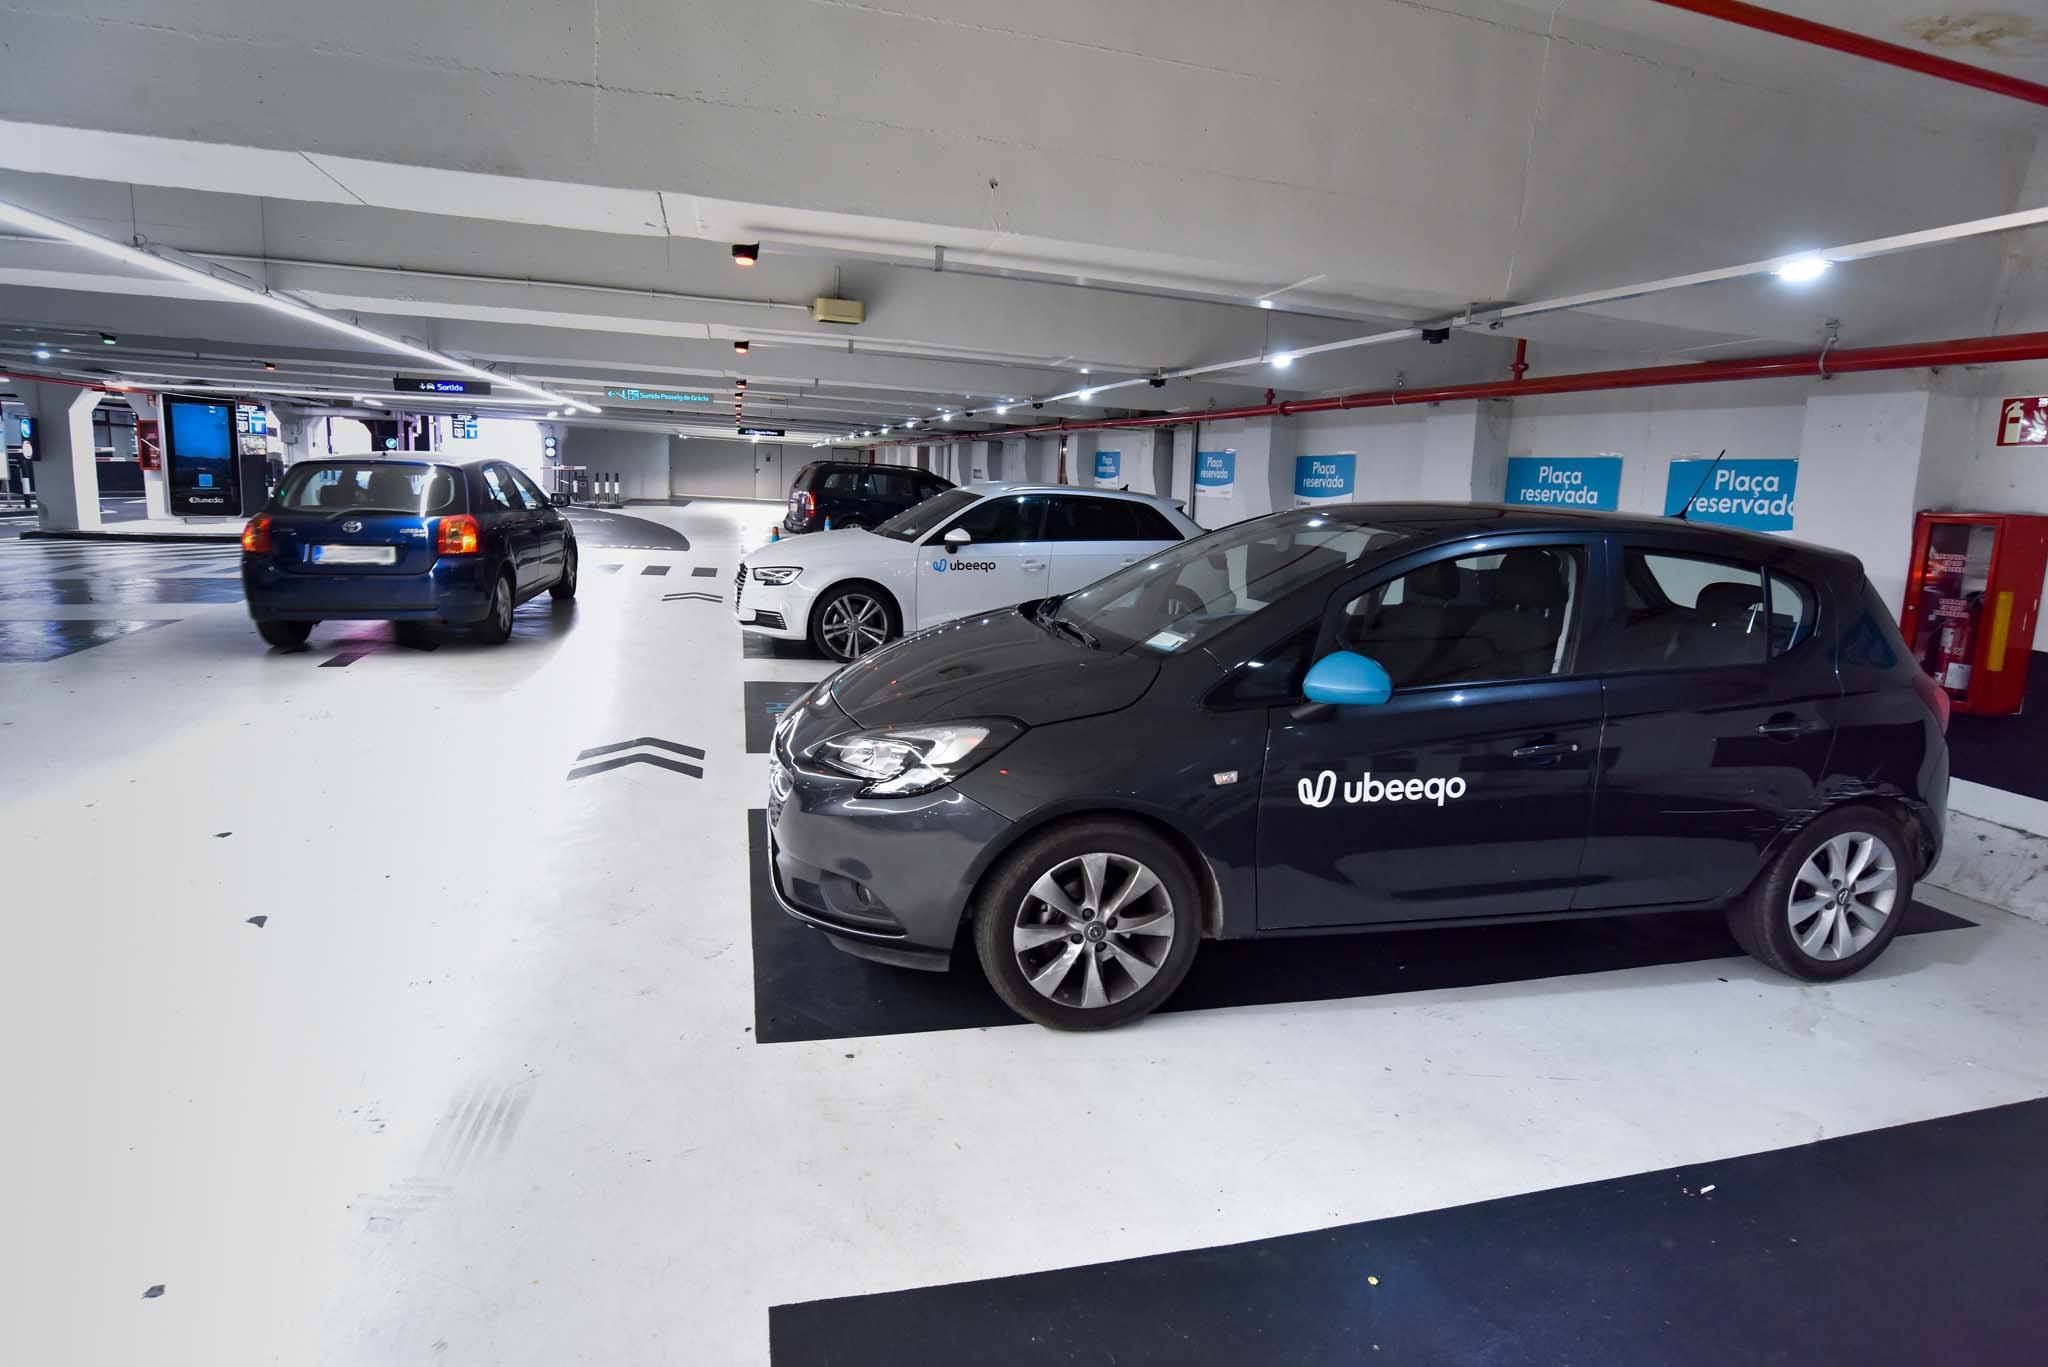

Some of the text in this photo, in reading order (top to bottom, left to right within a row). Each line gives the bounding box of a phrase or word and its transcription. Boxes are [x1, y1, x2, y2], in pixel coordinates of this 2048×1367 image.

[437, 383, 464, 391] Sortida
[1207, 456, 1223, 469] Plaça
[1312, 461, 1336, 477] Plaça
[1200, 468, 1229, 479] reservada
[1538, 466, 1582, 489] Plaça
[1303, 475, 1344, 488] reservada
[1715, 469, 1780, 497] Plaça
[1520, 485, 1598, 504] reservada
[950, 560, 996, 572] ubeeqo
[1344, 772, 1466, 806] ubeeqo
